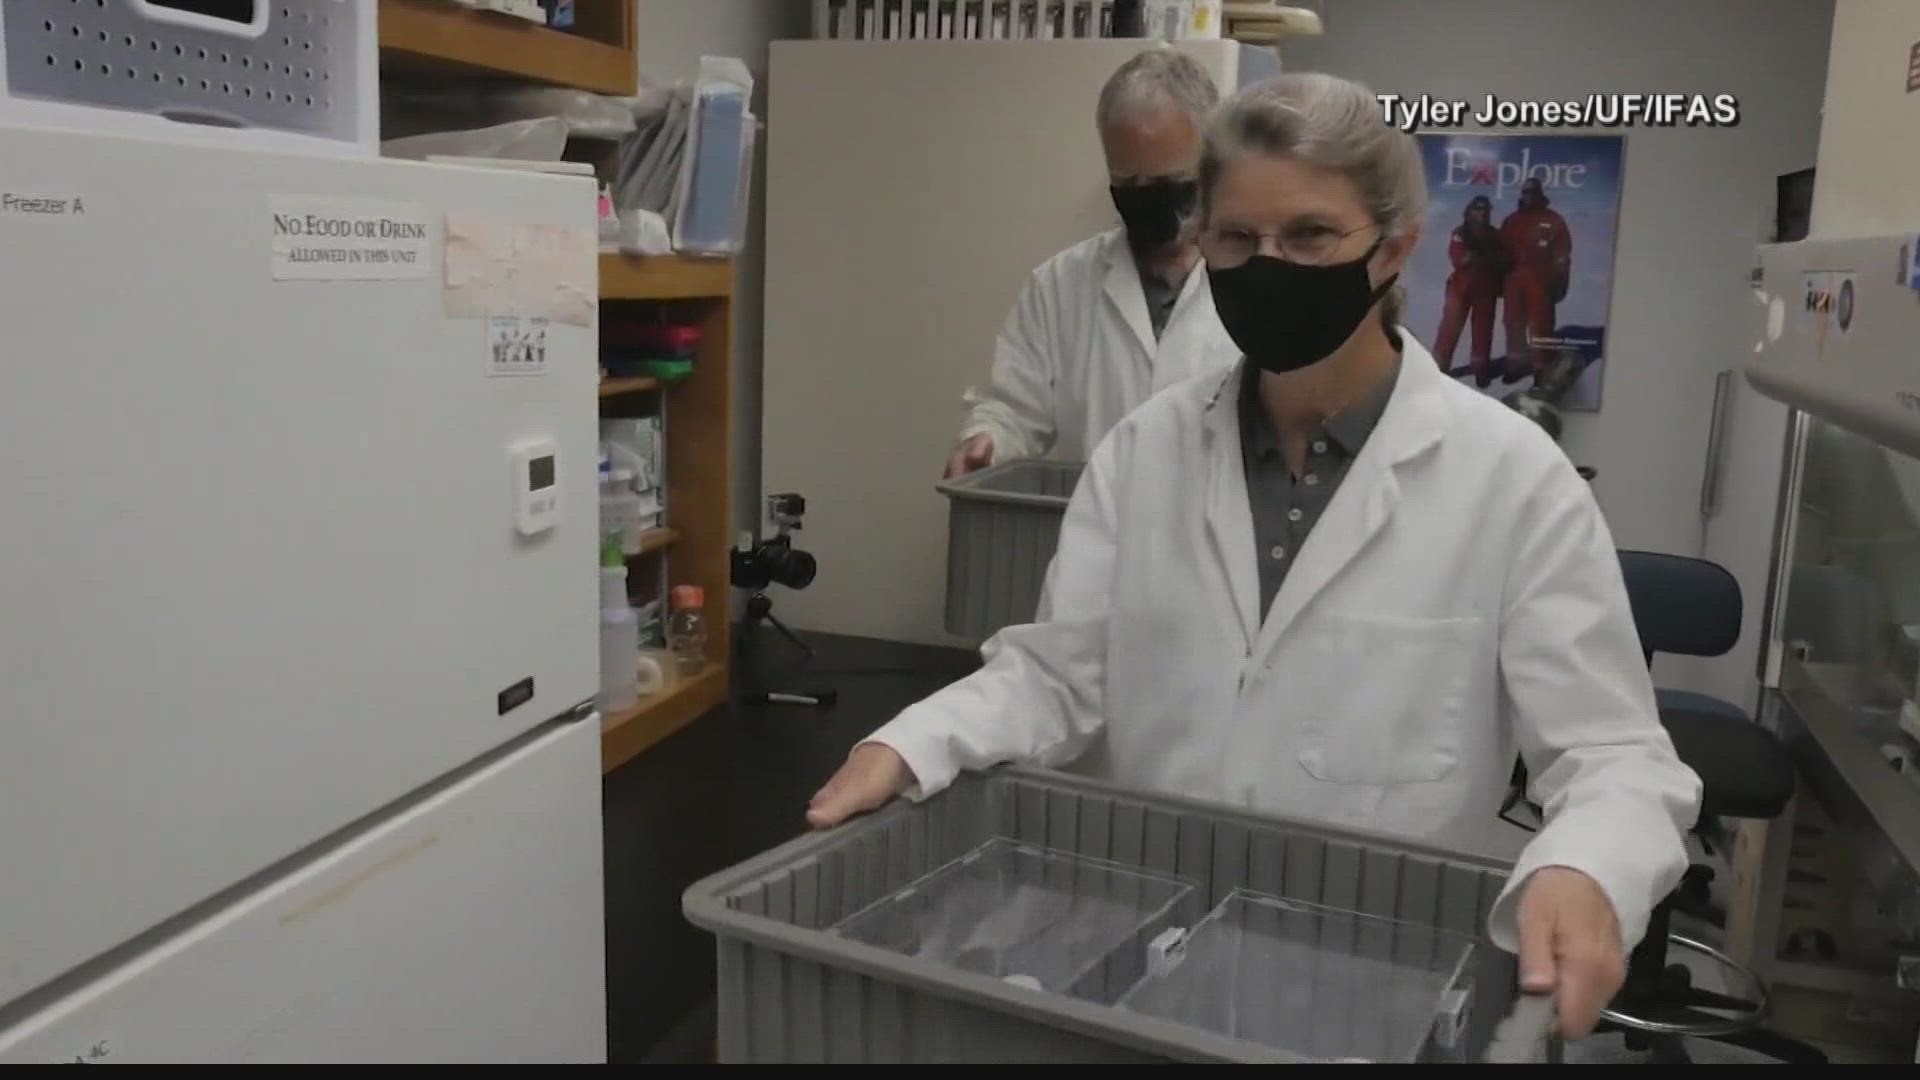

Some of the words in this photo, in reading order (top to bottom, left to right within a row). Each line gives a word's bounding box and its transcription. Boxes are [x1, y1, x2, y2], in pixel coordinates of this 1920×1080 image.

[1444, 147, 1587, 199] Explore
[3, 193, 67, 214] Freezer
[73, 196, 85, 215] A
[273, 213, 302, 236] NO
[305, 214, 351, 237] FOOD
[354, 220, 377, 238] OR
[380, 218, 427, 239] DRINK
[288, 248, 346, 263] ALLOWED
[350, 249, 362, 263] IN
[365, 250, 389, 263] THIS
[391, 251, 416, 264] UNIT
